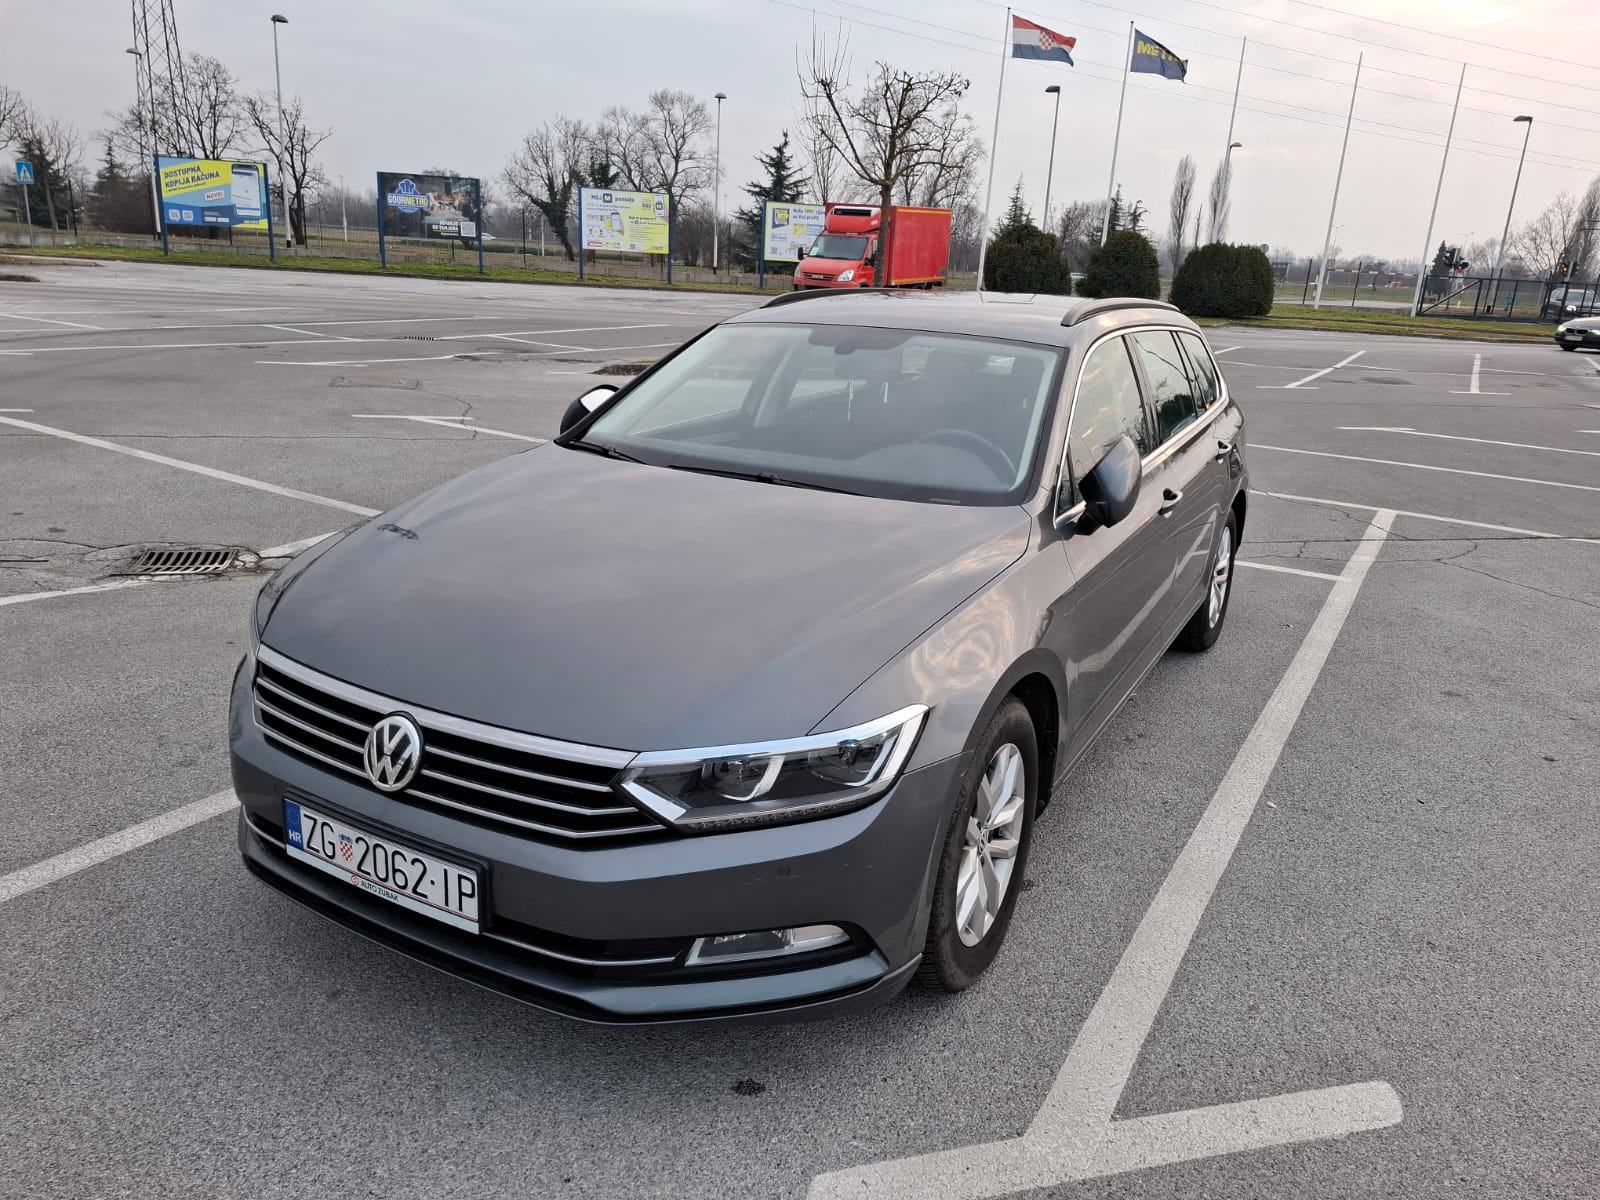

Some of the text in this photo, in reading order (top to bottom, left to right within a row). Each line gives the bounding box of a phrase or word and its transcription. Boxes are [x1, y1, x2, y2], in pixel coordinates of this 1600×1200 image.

[164, 165, 202, 178] DOSTUPNA
[165, 178, 191, 188] KOPIJA
[191, 171, 220, 183] RAČUNA
[387, 194, 429, 206] GOURMETRO
[288, 829, 302, 843] HR
[303, 813, 336, 860] ZG
[360, 880, 399, 902] AUTO ZUBAK
